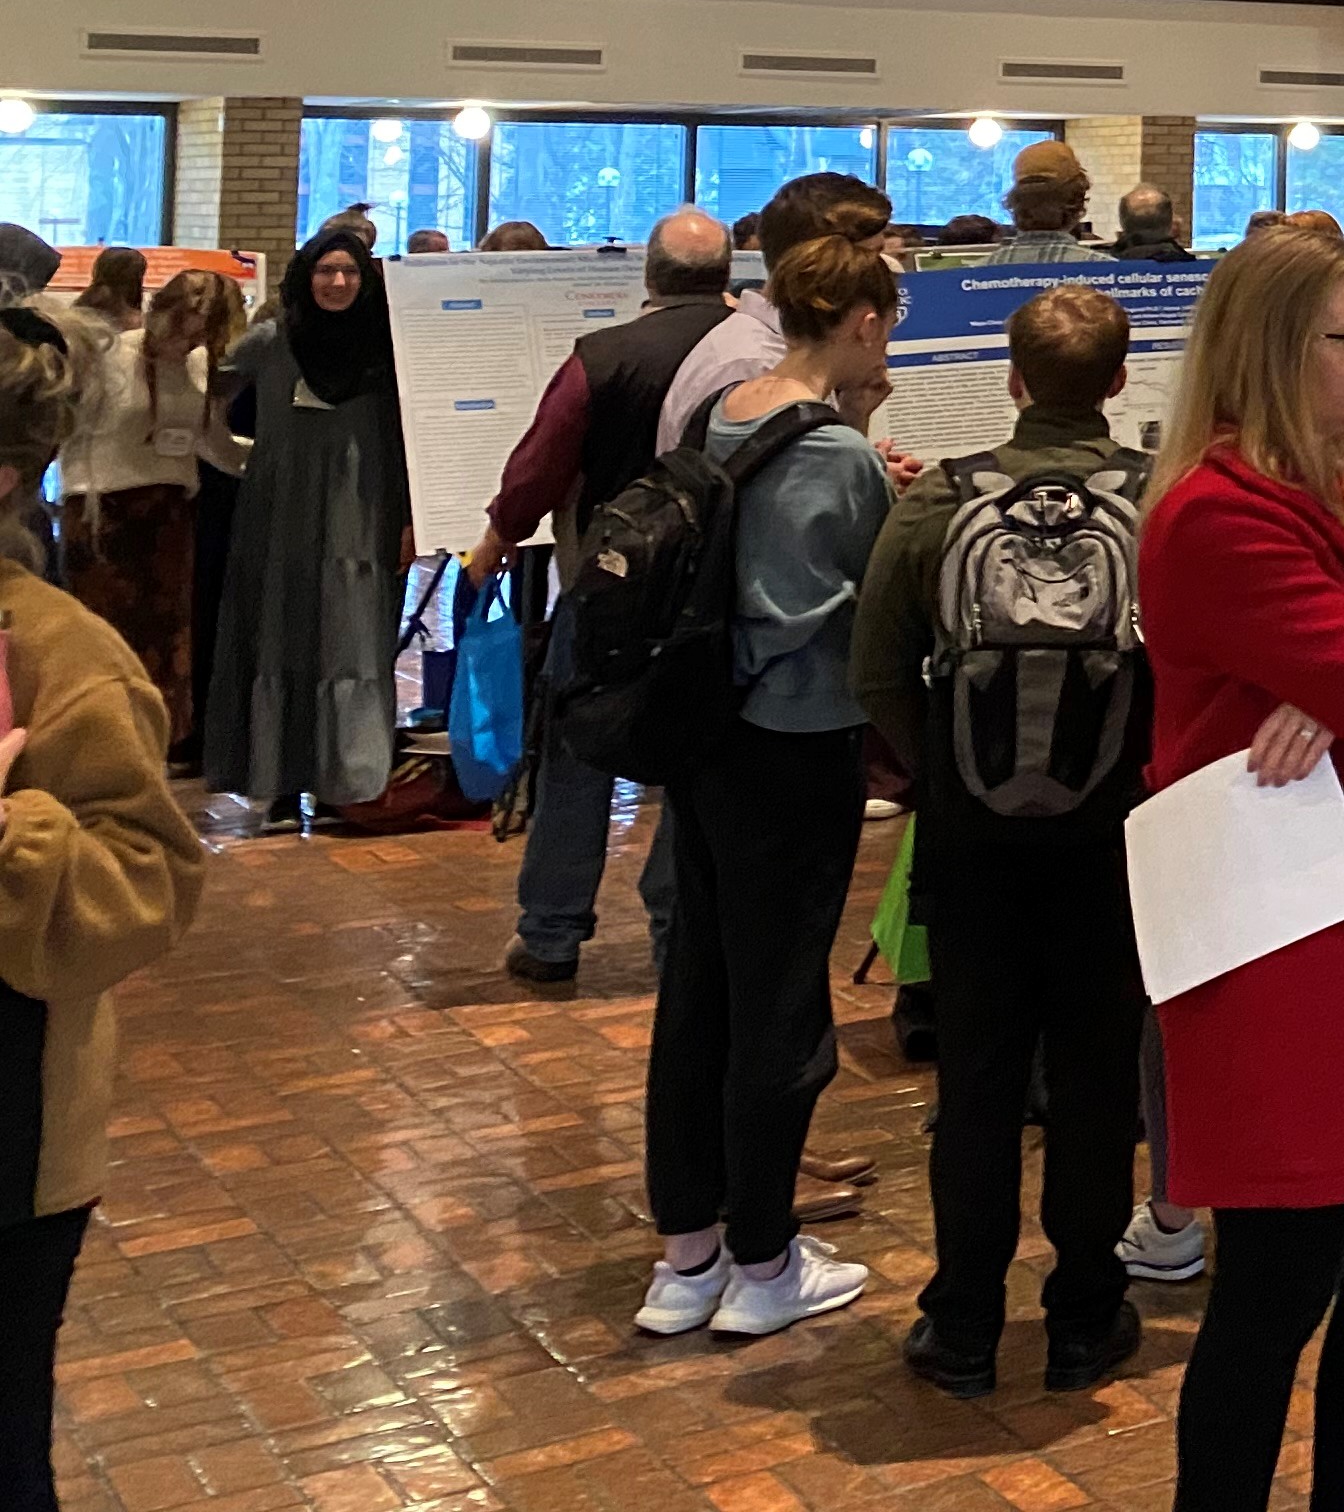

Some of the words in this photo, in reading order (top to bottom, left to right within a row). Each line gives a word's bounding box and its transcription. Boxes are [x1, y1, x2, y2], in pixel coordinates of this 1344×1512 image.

[961, 273, 1115, 291] Chemotherapy-induced
[1117, 273, 1163, 284] cellular
[1159, 286, 1173, 297] of
[932, 351, 979, 362] ABSTRACT
